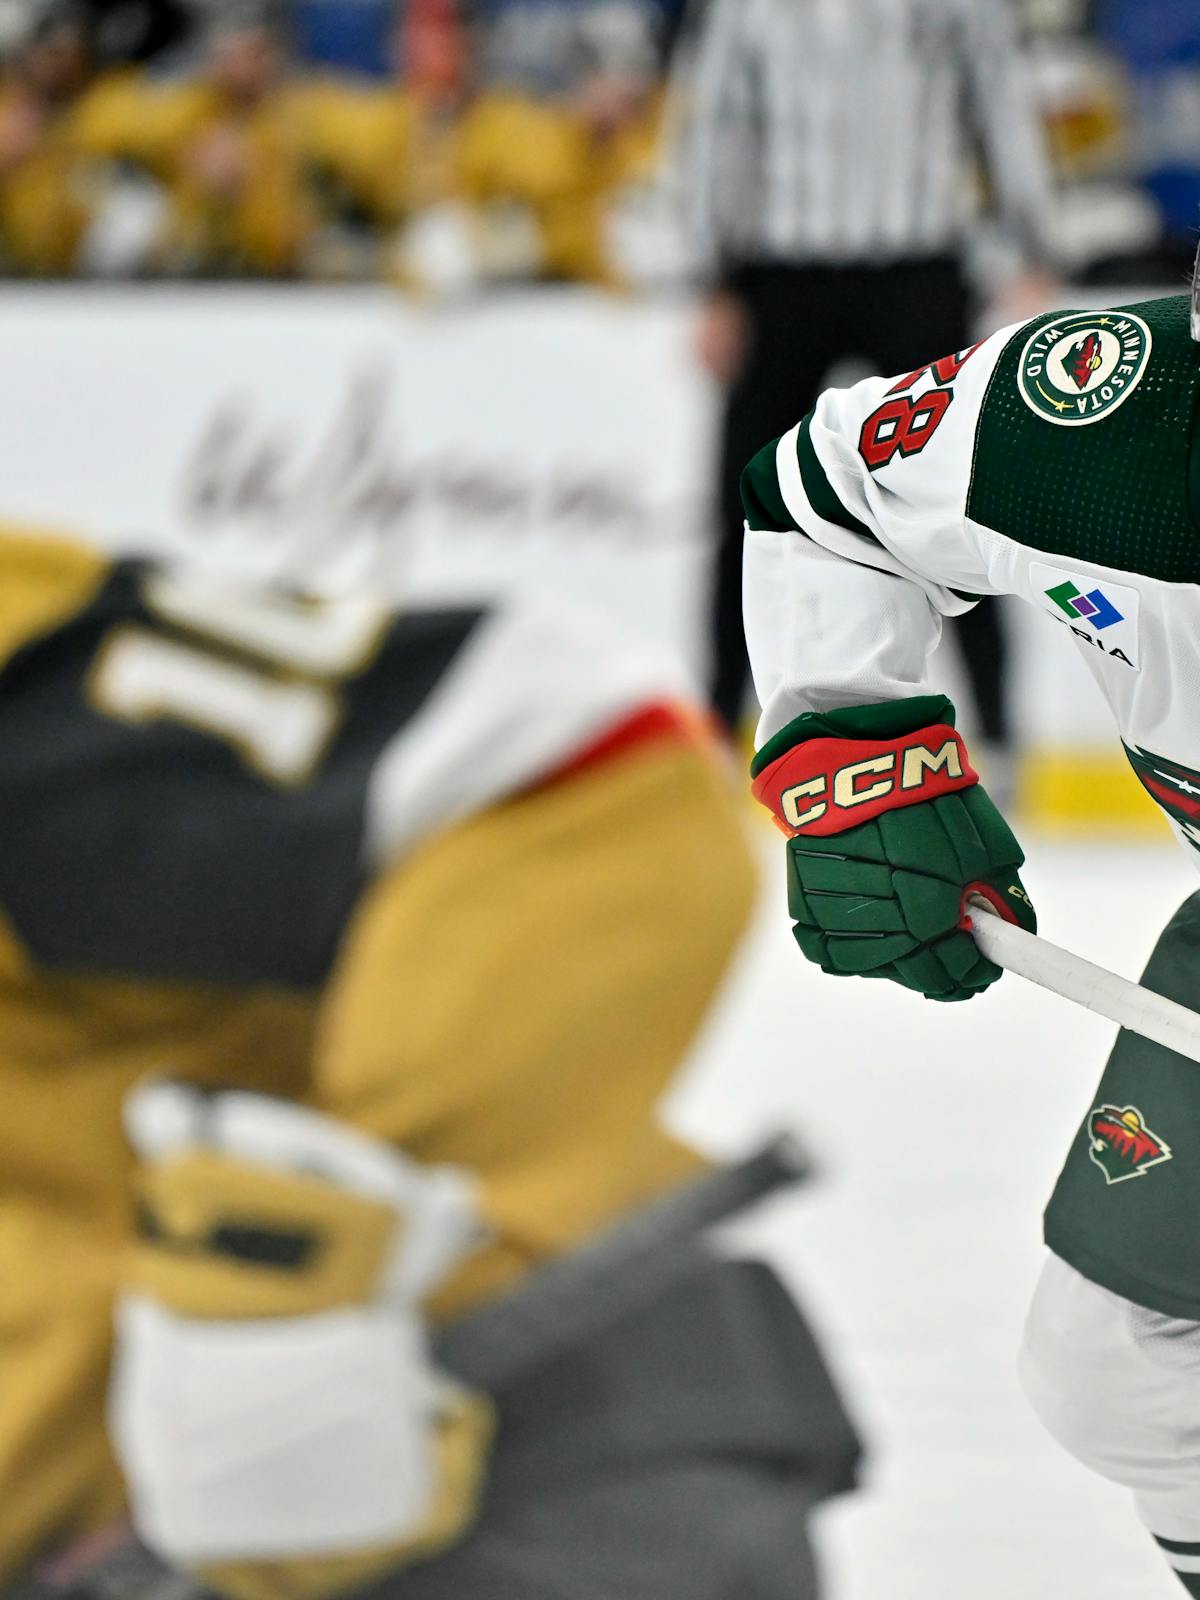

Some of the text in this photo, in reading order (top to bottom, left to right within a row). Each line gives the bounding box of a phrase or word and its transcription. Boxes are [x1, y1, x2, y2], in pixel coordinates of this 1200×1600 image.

[1026, 320, 1141, 414] MINNESOTA WILD
[780, 740, 964, 828] CCM
